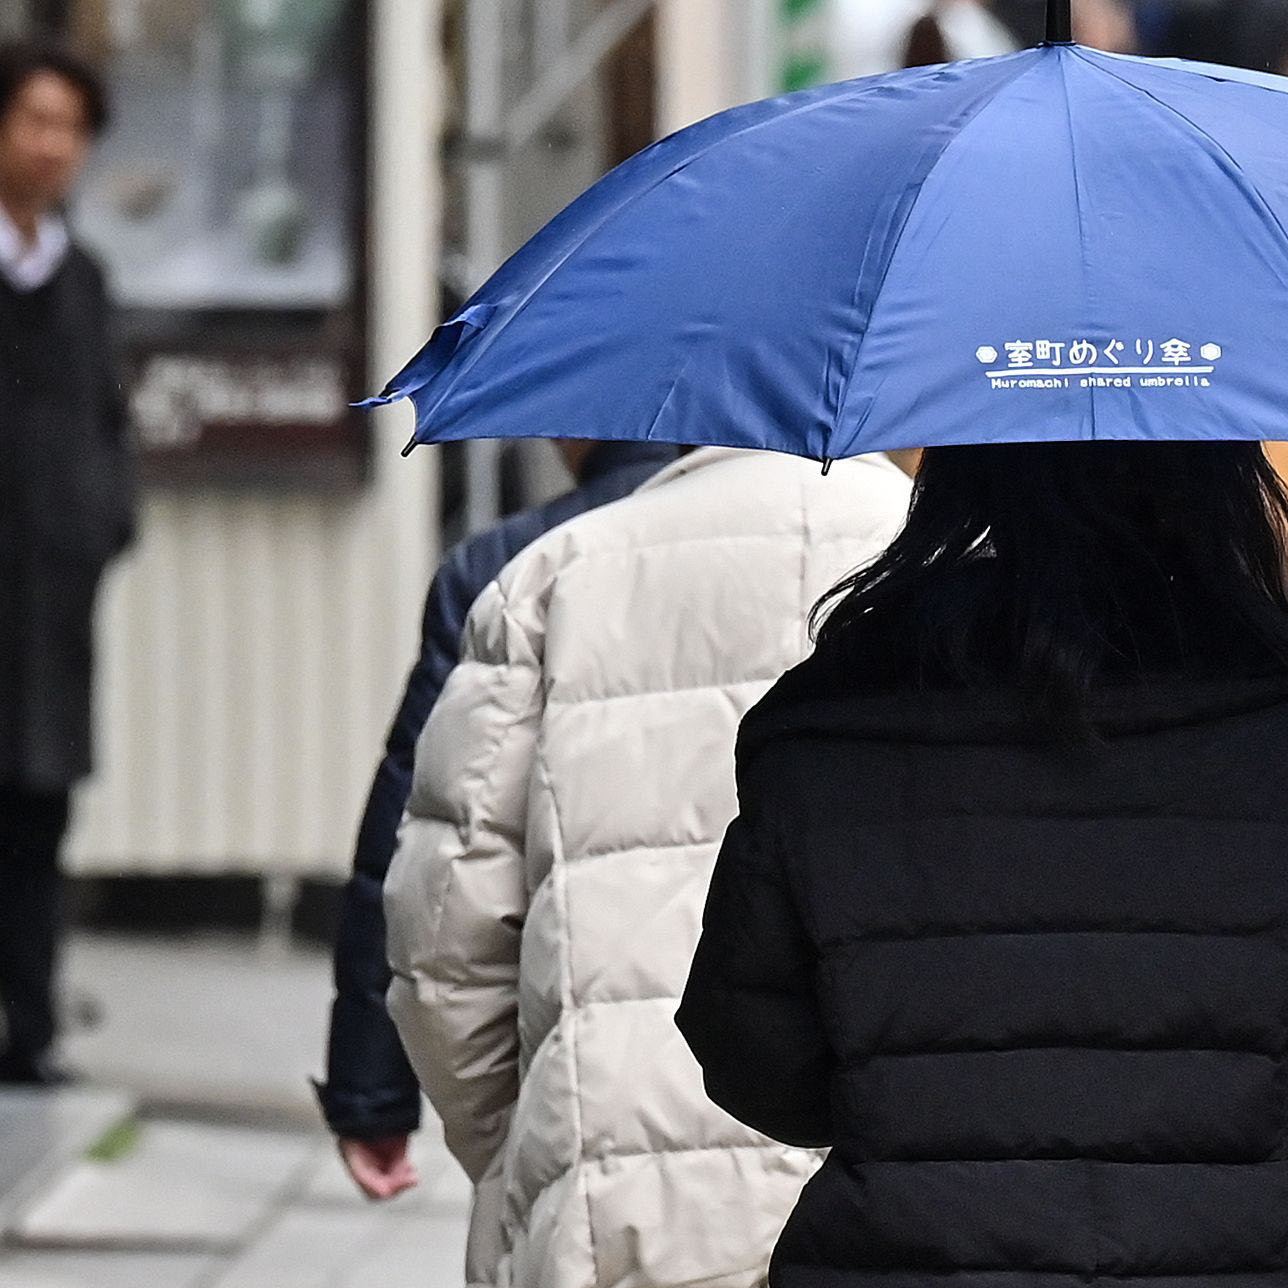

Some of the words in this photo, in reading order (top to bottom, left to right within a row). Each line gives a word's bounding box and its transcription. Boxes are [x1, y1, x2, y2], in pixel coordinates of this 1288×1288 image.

[1004, 338, 1192, 368] 室町めぐり傘
[991, 377, 1069, 389] Muromachi
[1080, 376, 1131, 388] shared
[1139, 376, 1210, 387] umbrella
